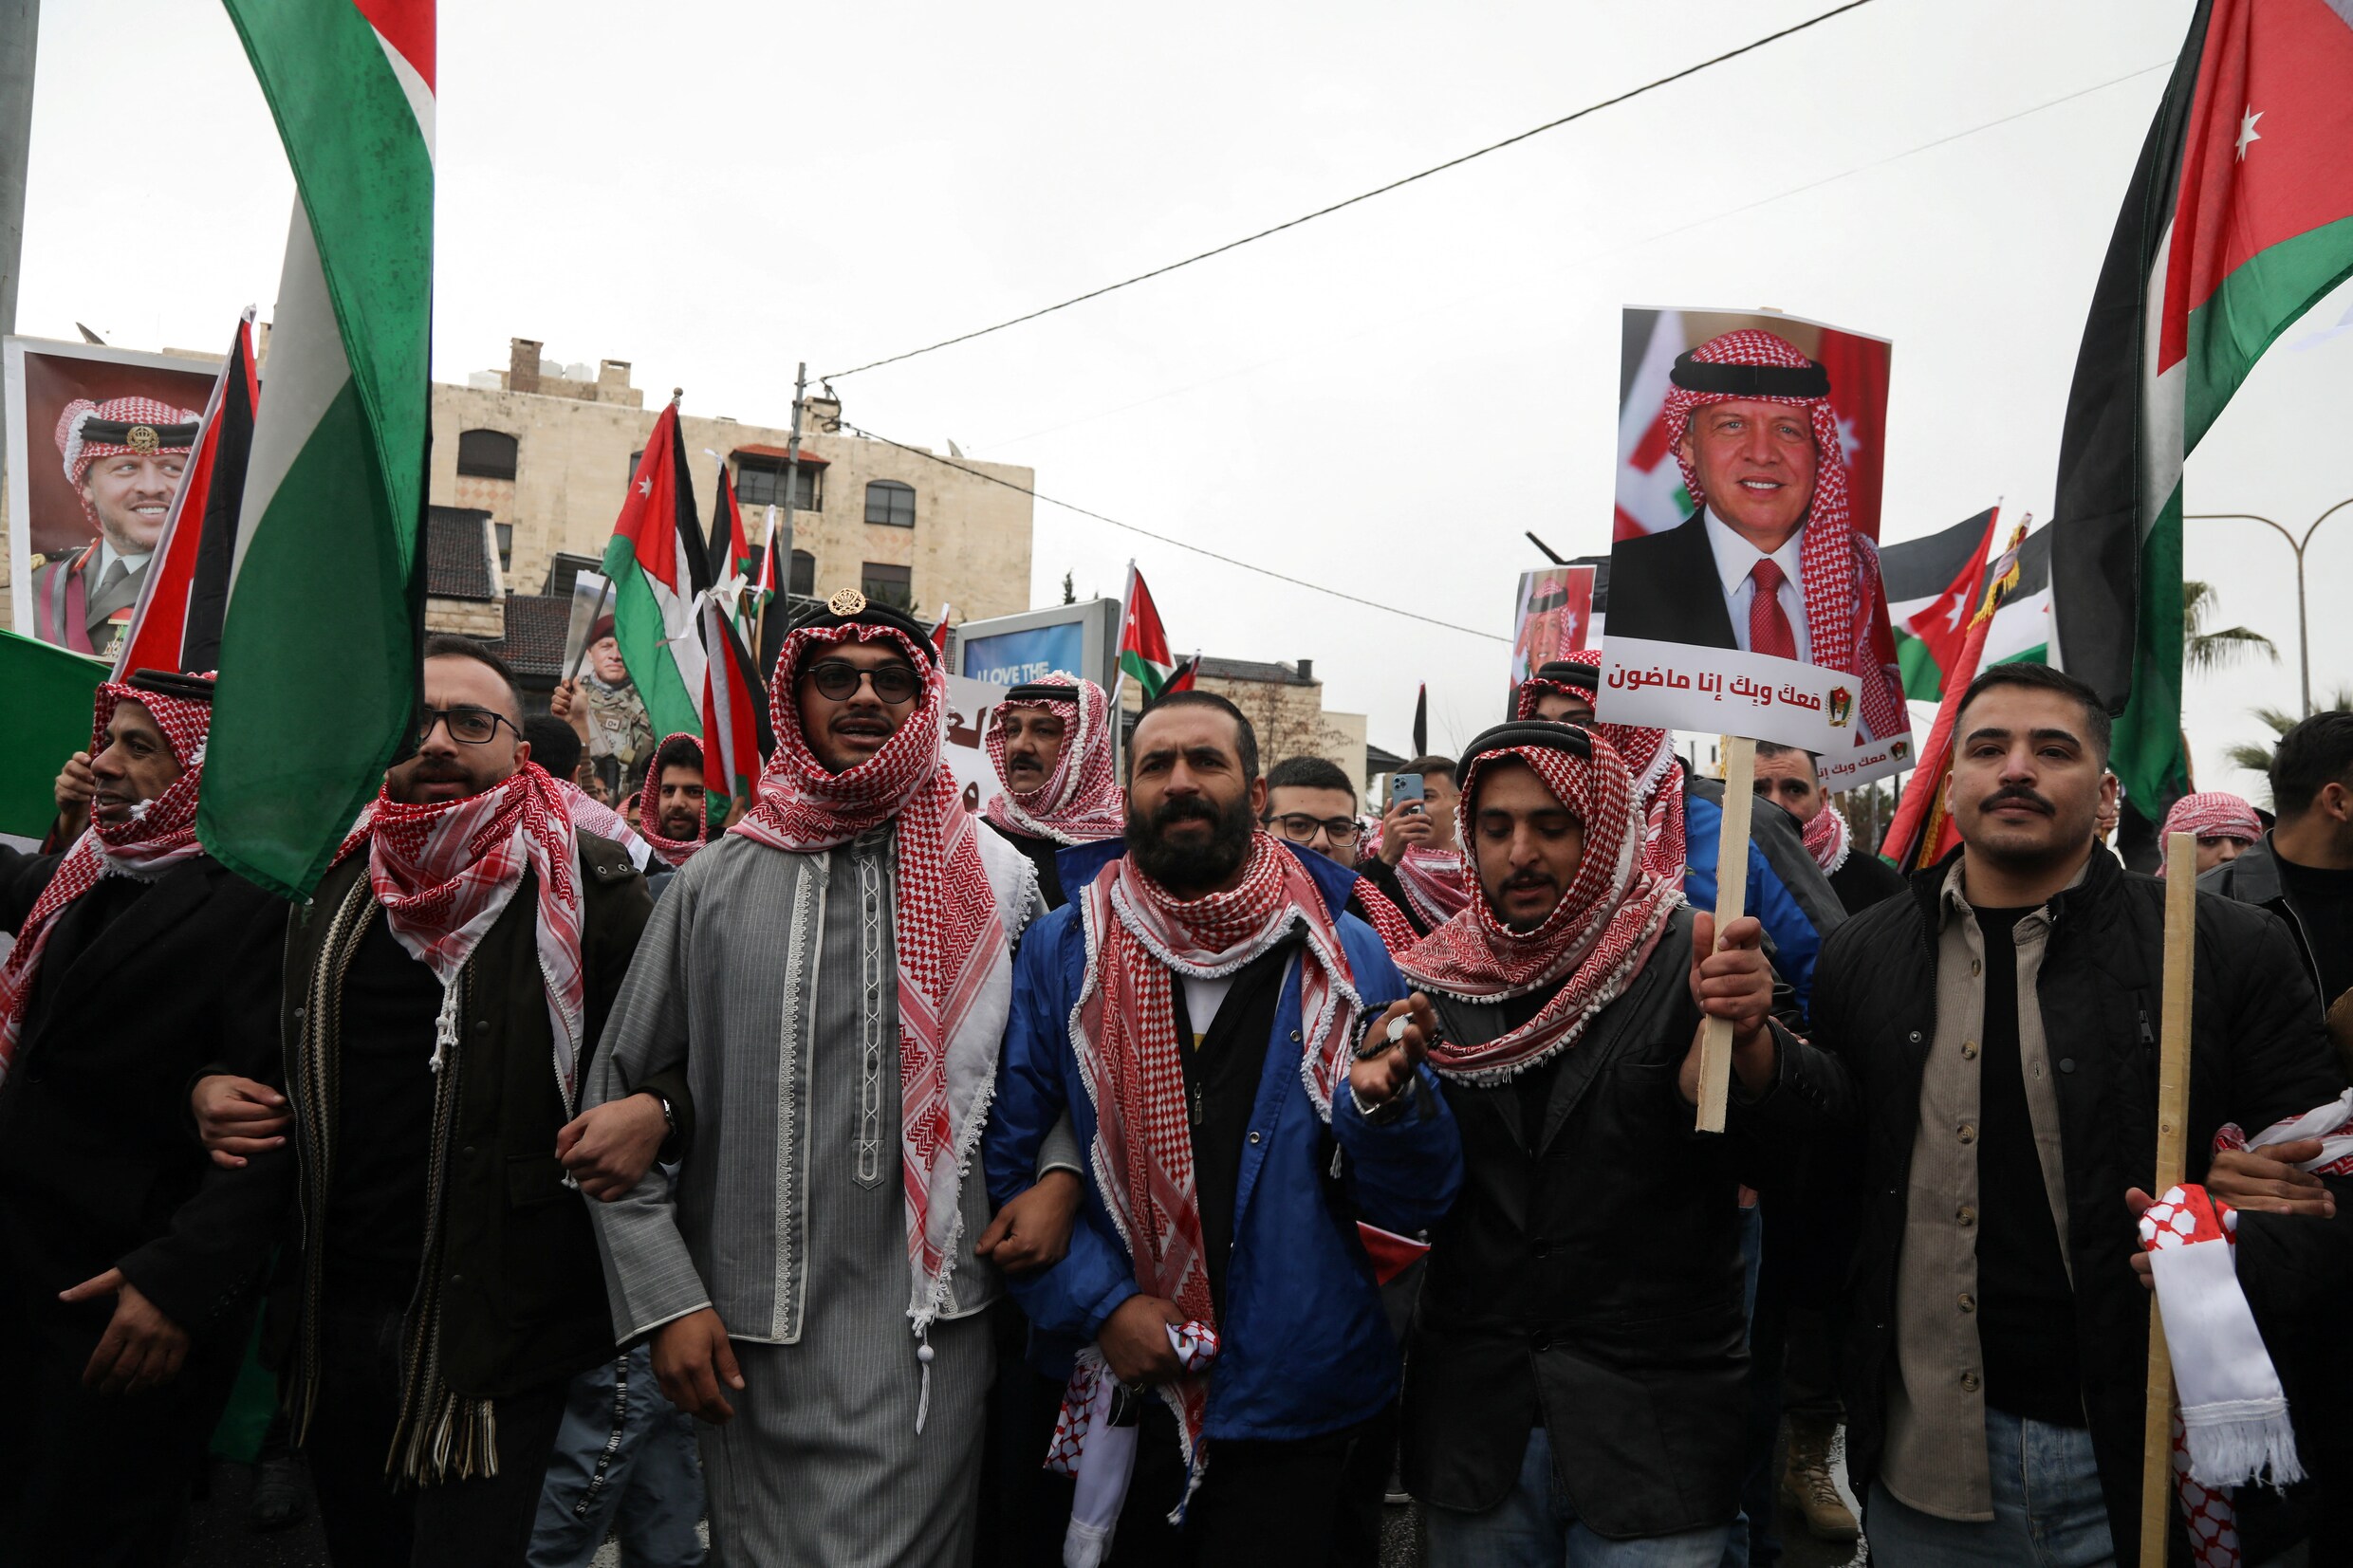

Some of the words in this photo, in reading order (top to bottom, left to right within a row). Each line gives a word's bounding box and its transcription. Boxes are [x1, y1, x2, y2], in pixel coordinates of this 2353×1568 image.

[1607, 663, 1692, 692] ماضون
[1697, 672, 1723, 702] إنا
[1817, 766, 1829, 781] إن
